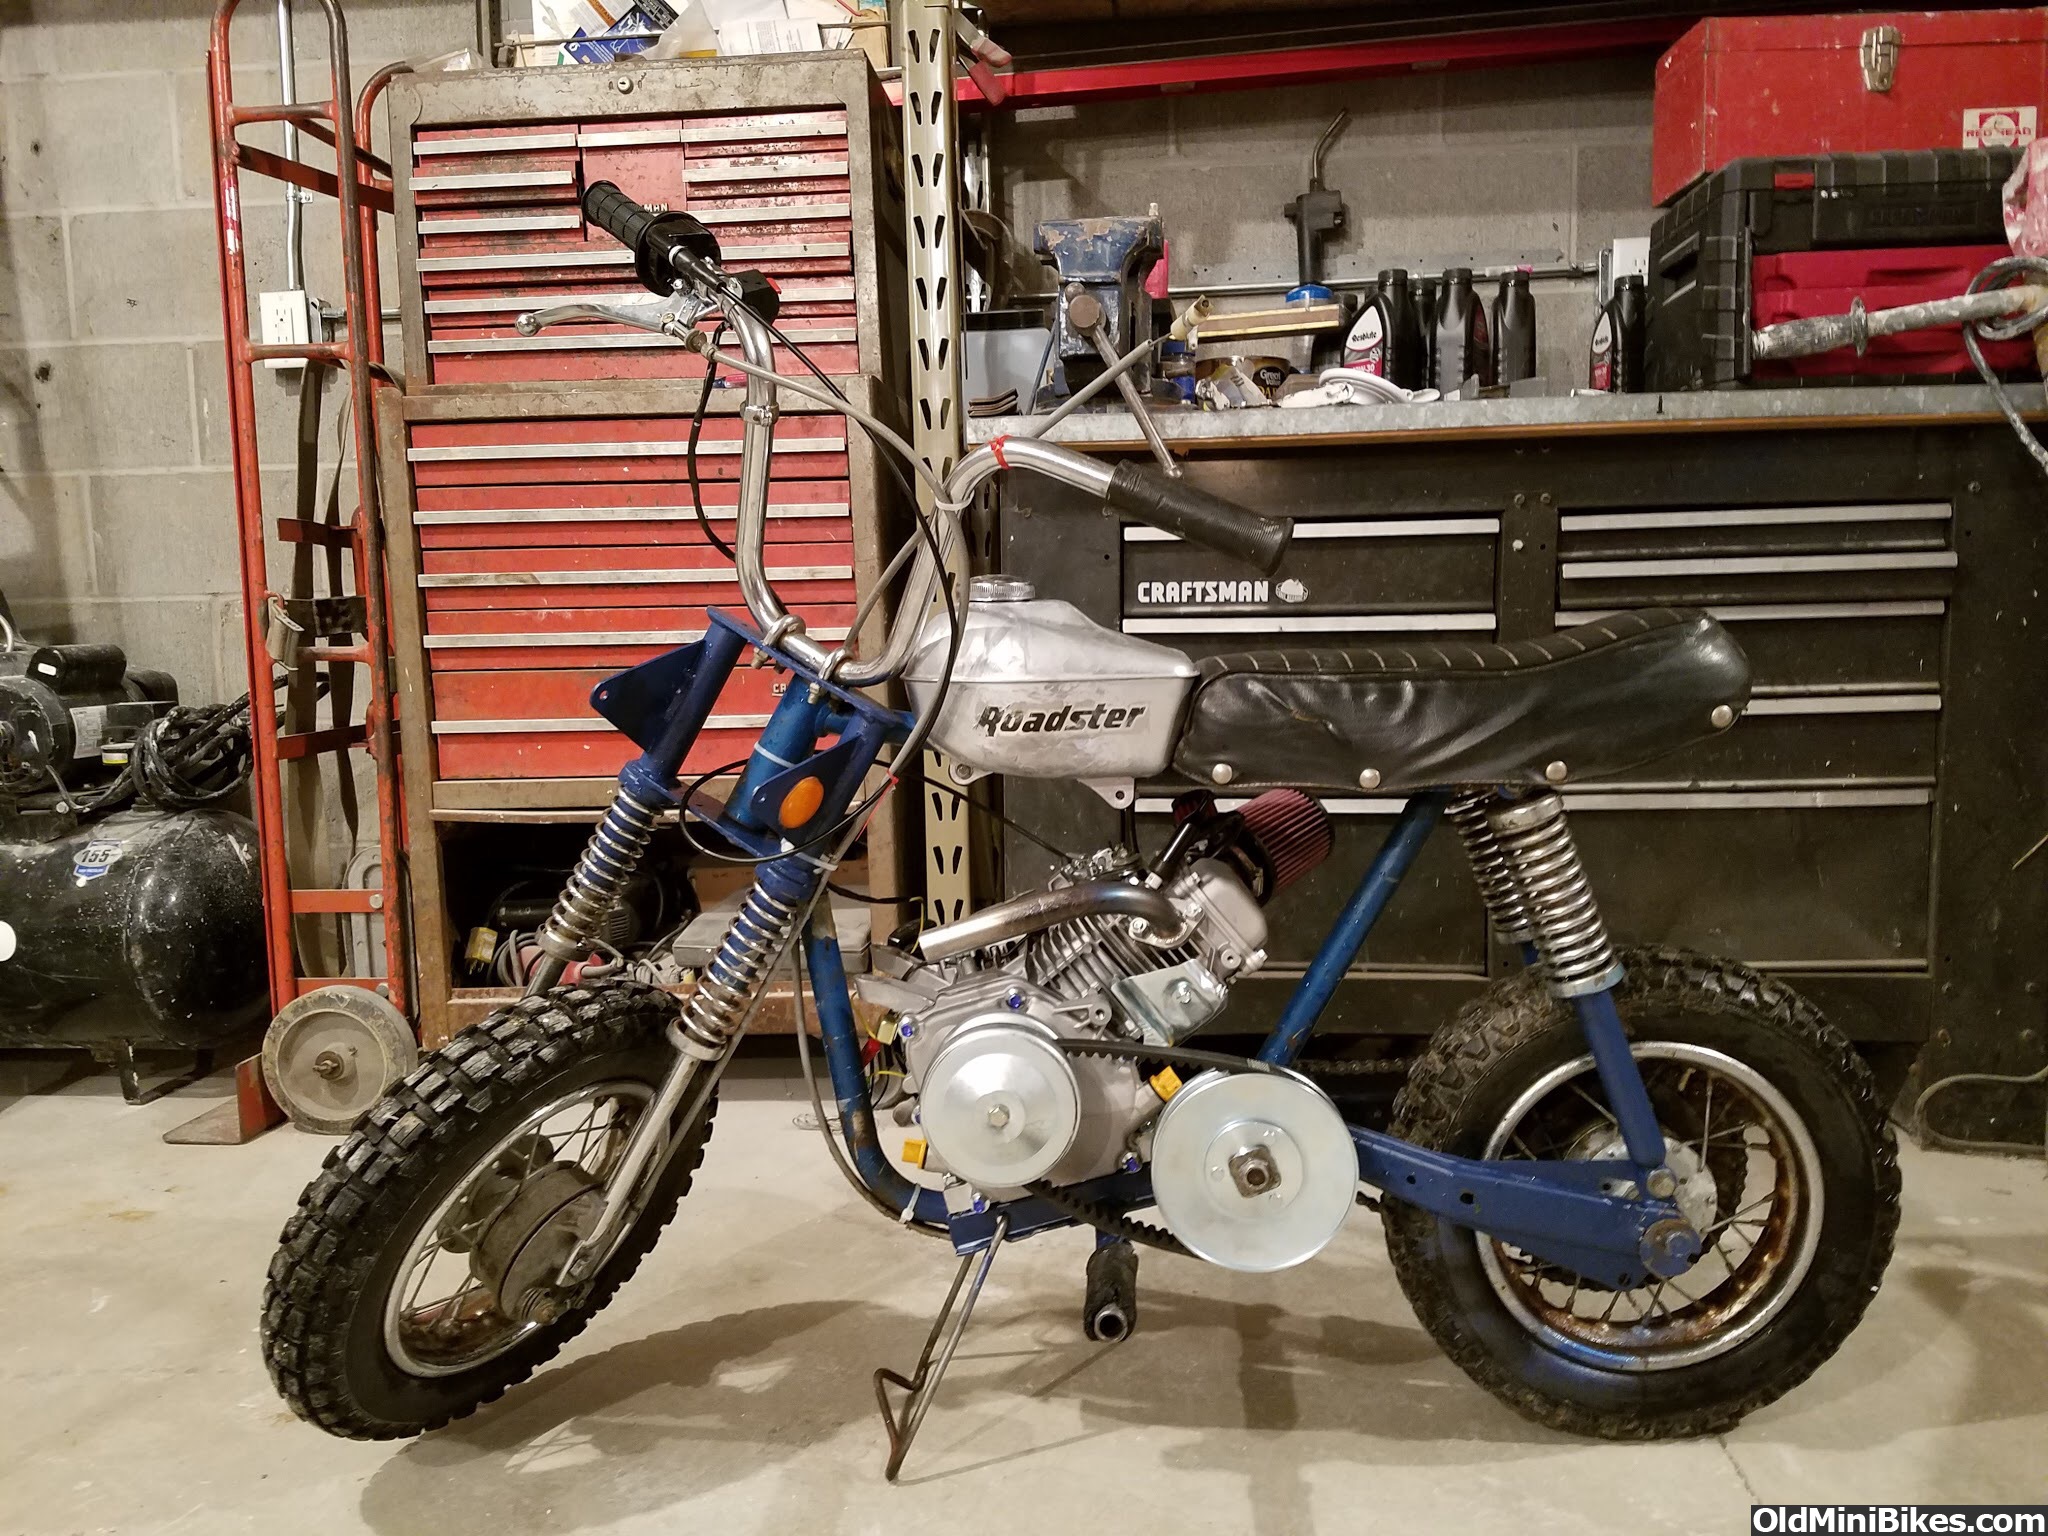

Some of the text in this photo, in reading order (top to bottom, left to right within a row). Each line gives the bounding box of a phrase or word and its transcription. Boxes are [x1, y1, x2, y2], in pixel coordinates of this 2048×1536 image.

[1137, 581, 1269, 603] CRAFTSMAN
[976, 703, 1146, 737] Roadster
[81, 849, 112, 863] 155
